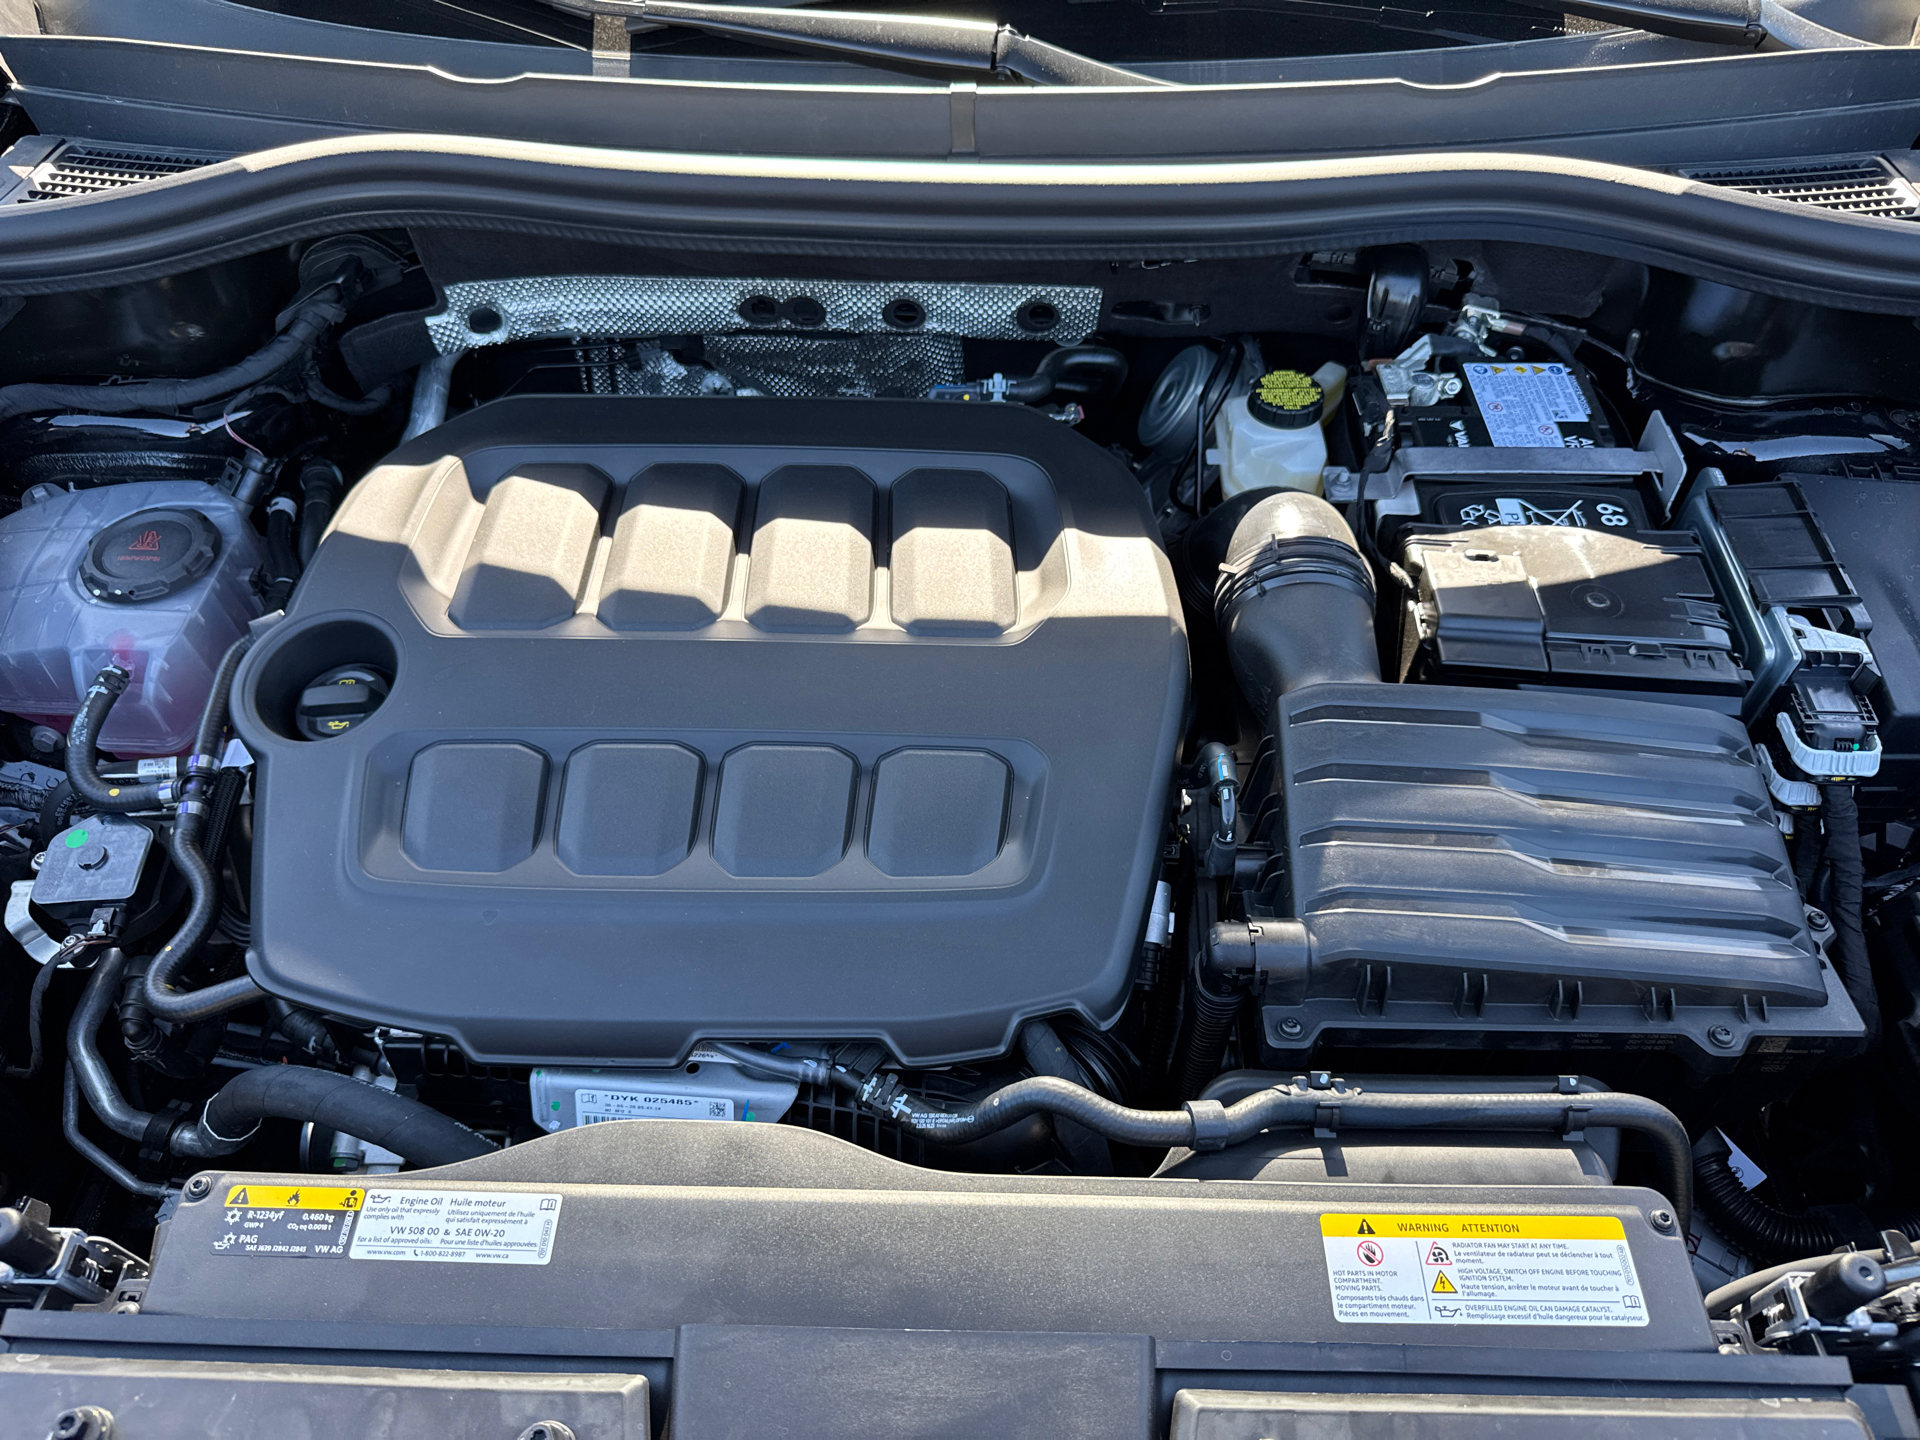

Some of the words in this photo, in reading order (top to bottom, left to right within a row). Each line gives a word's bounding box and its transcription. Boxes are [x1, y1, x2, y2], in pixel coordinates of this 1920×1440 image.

[400, 1197, 429, 1207] Engine
[430, 1197, 443, 1206] Oil
[450, 1198, 473, 1207] Huile
[378, 1206, 391, 1214] only
[247, 1210, 285, 1221] R-1234yf
[302, 1213, 324, 1221] 0.460
[325, 1214, 335, 1223] kg
[363, 1213, 390, 1221] complies
[481, 1218, 523, 1226] expressément
[390, 1226, 407, 1234] VW
[407, 1227, 426, 1235] 508
[427, 1227, 440, 1236] 00
[455, 1228, 473, 1237] SAE
[474, 1229, 506, 1238] 0W-20
[1397, 1223, 1449, 1232] WARNING
[1461, 1223, 1520, 1233] ATTENTION
[239, 1235, 258, 1243] PAG
[391, 1237, 418, 1245] approved
[314, 1245, 330, 1253] VW
[330, 1245, 344, 1254] AG
[1466, 1312, 1506, 1320] Remplissage
[1554, 1313, 1587, 1321] dangereux
[1611, 1314, 1645, 1322] catalyseur.
